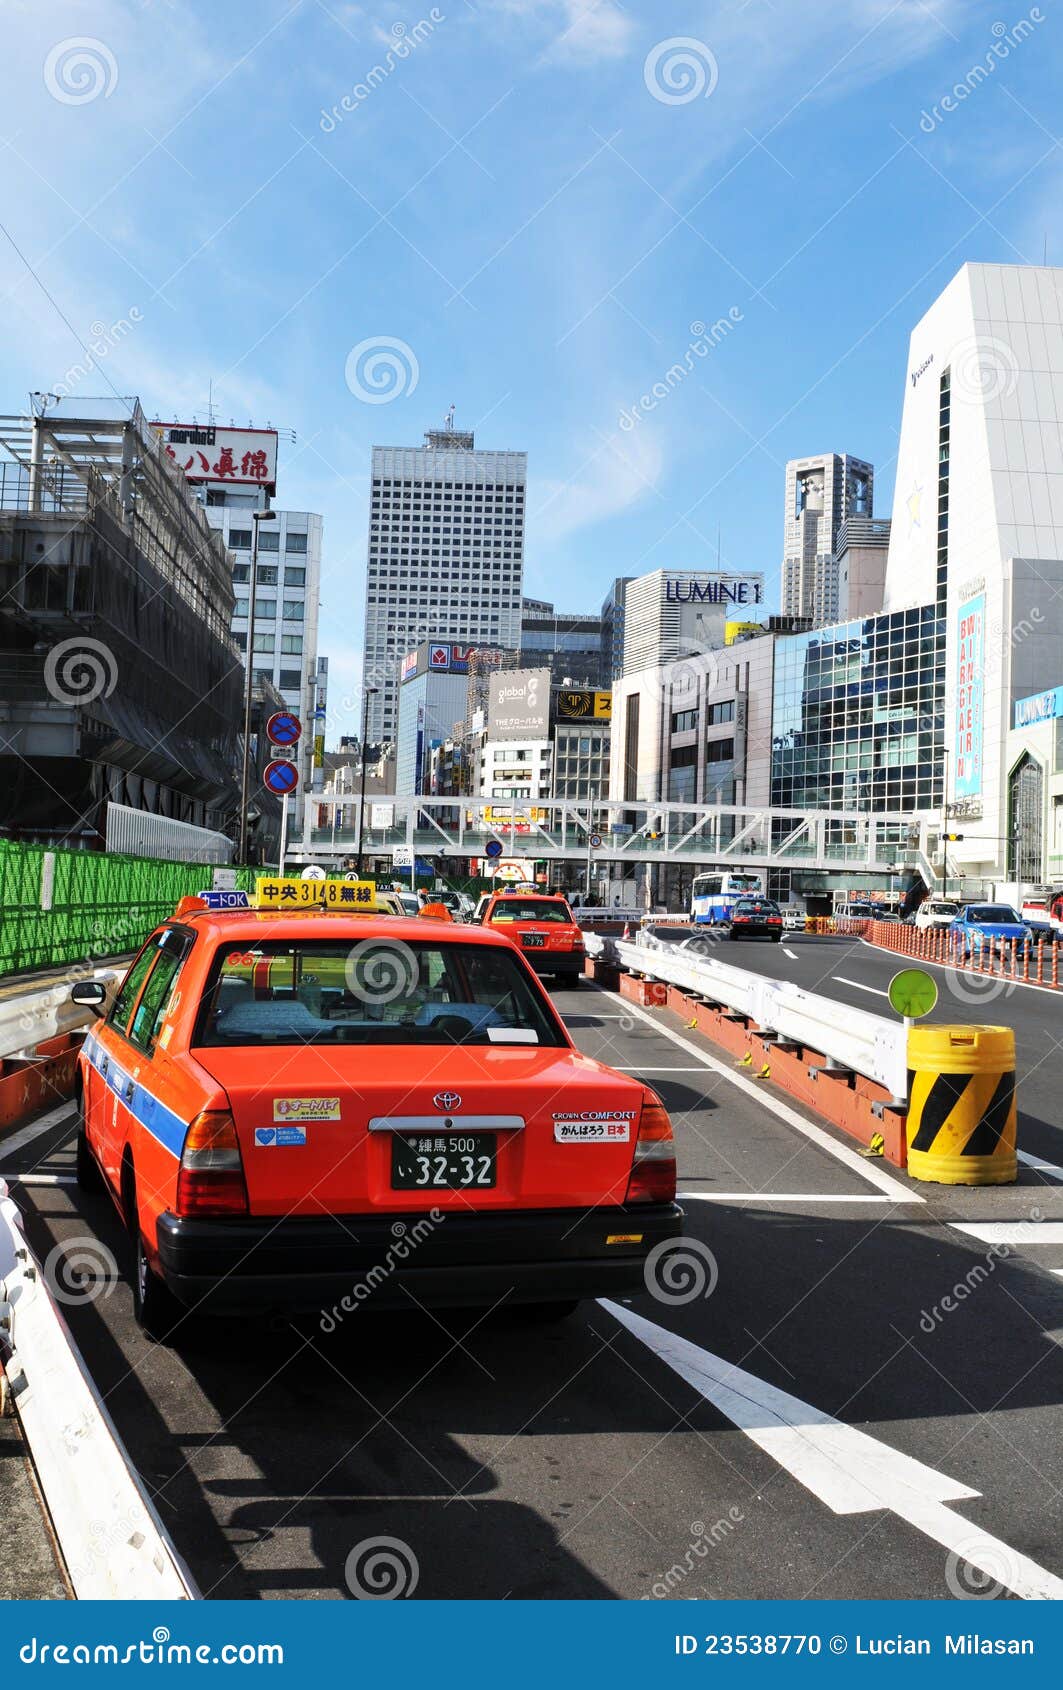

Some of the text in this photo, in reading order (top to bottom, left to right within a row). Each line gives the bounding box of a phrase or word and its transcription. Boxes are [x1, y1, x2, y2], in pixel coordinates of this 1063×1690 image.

[498, 684, 527, 704] global
[965, 614, 976, 752] WINTER
[957, 620, 967, 778] BARGAIN
[552, 1111, 636, 1121] CROWN COMFORT
[418, 1138, 475, 1153] 練馬 500
[416, 1156, 491, 1184] 32-32
